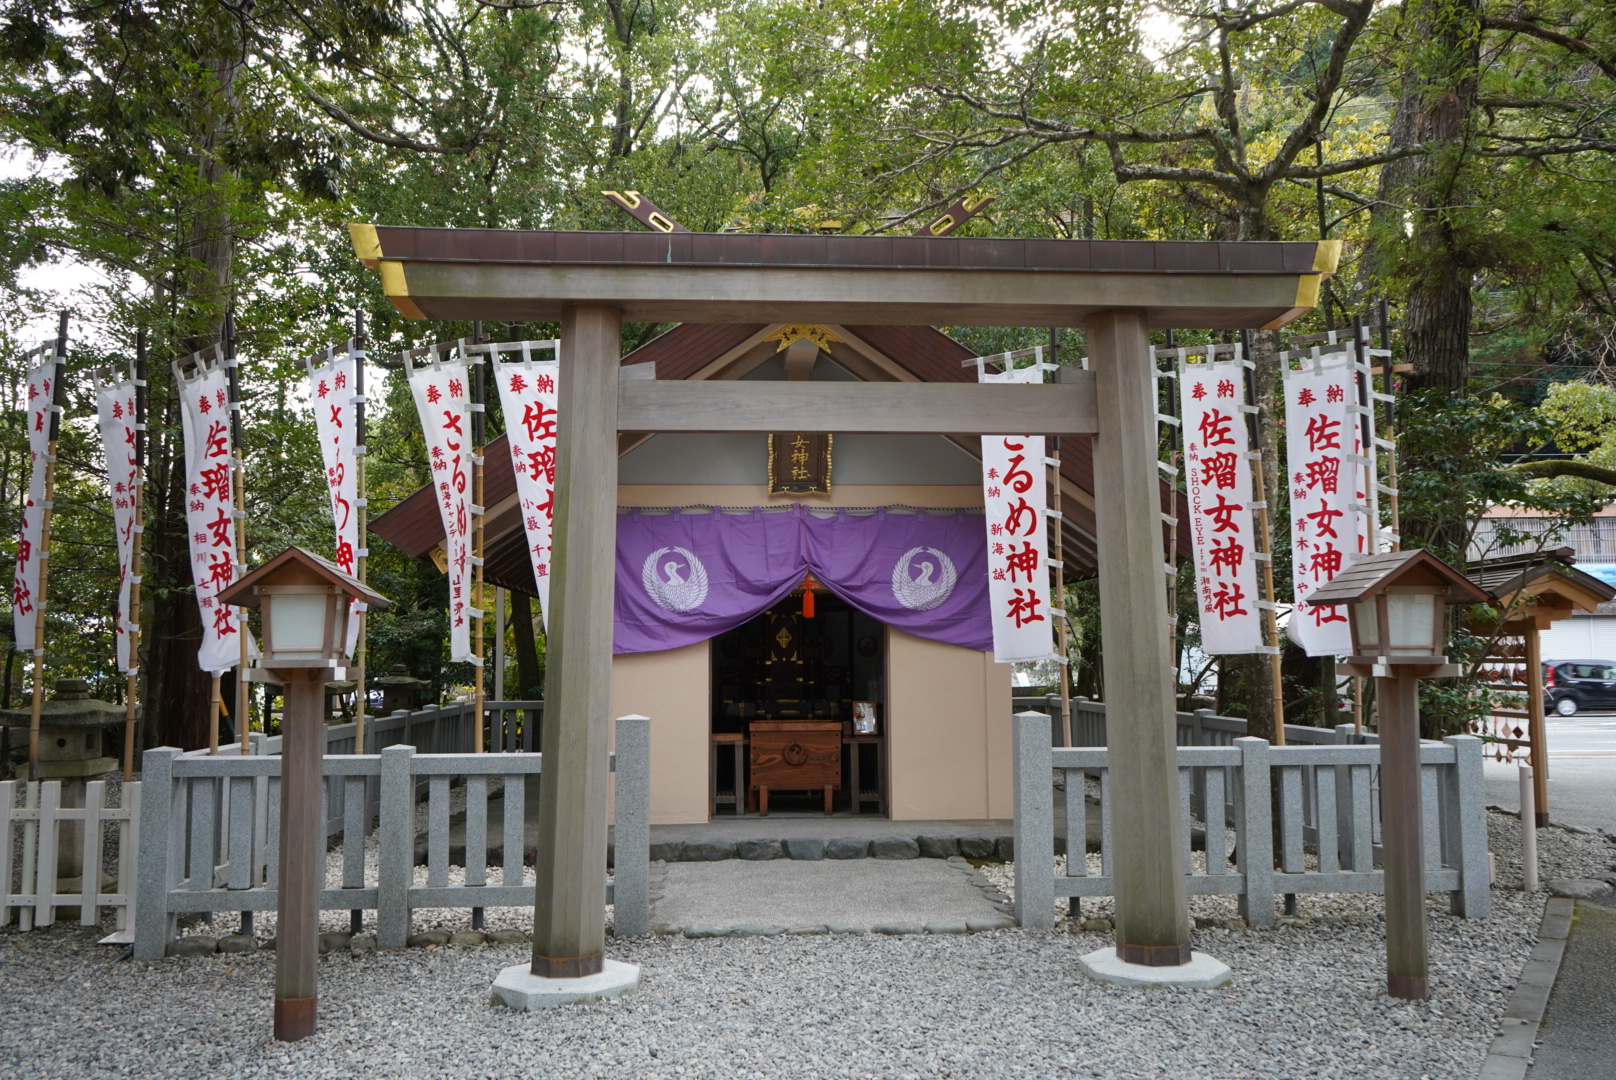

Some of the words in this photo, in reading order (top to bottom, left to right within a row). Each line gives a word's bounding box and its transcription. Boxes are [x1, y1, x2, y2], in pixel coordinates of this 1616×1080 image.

[317, 371, 346, 399] 奉納
[427, 378, 463, 405] 奉納
[509, 373, 555, 395] 奉納
[1191, 379, 1235, 401] 奉納
[1297, 384, 1344, 408] 奉納
[198, 388, 226, 415] 奉納
[431, 446, 447, 472] 奉納
[512, 445, 527, 473] 奉納
[1189, 442, 1198, 461] 奉納
[114, 481, 128, 509] 奉納
[987, 468, 1000, 498] 奉納
[1191, 468, 1202, 514] SHOCK
[1293, 472, 1307, 499] 奉納
[189, 482, 205, 512] 奉納
[1198, 408, 1248, 621] 佐瑠女神社
[1195, 518, 1204, 545] EYE
[1200, 576, 1215, 613] 湘南乃風
